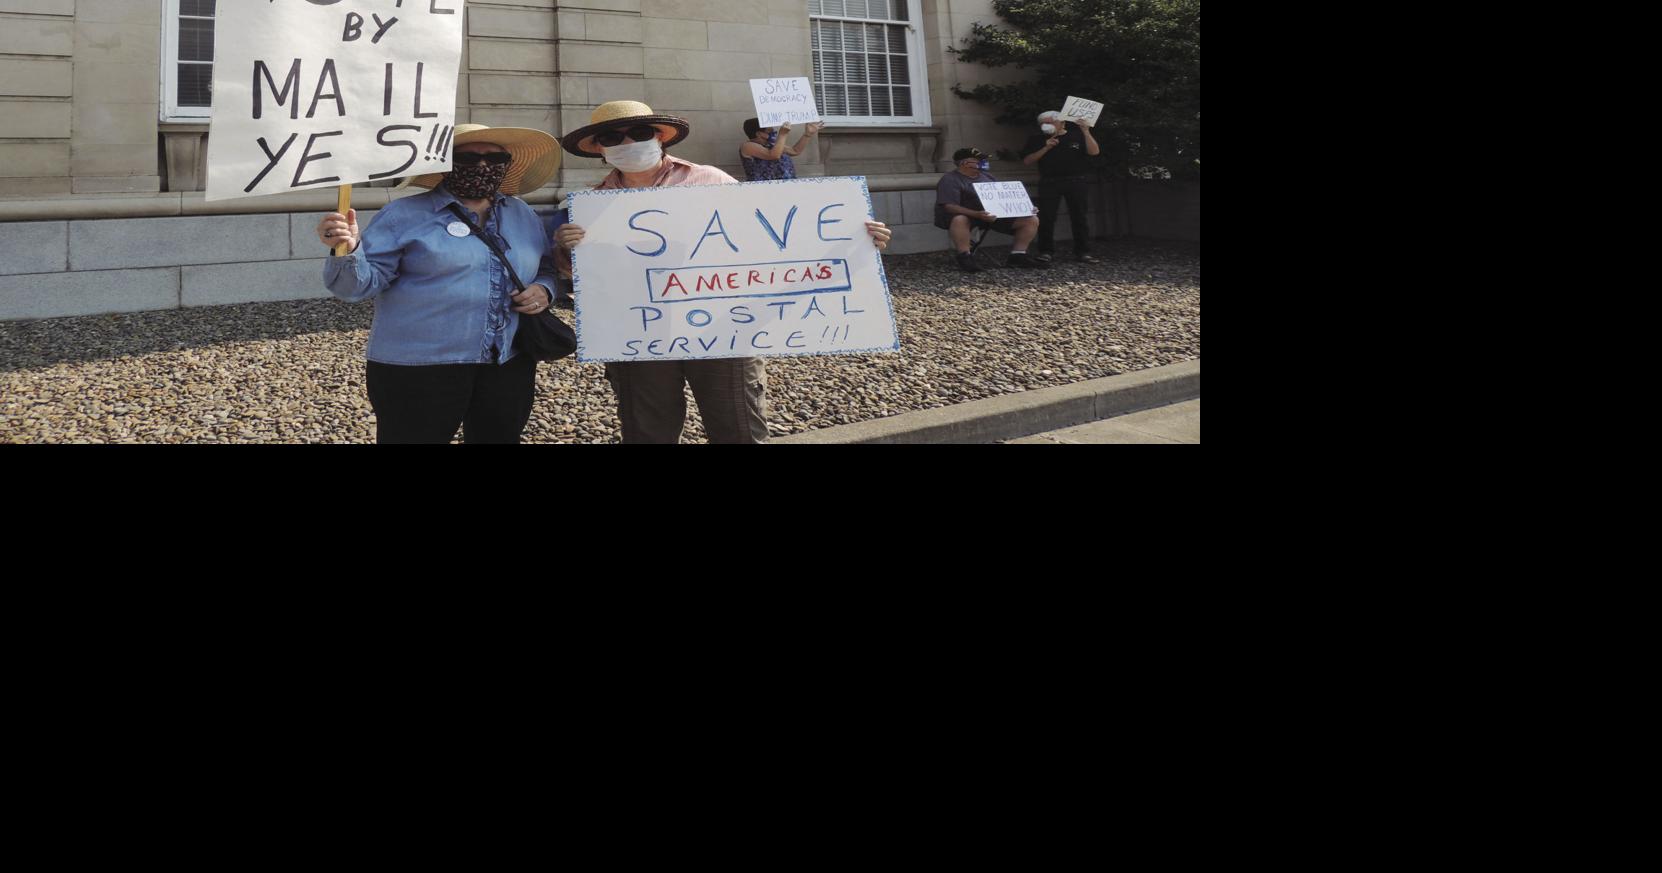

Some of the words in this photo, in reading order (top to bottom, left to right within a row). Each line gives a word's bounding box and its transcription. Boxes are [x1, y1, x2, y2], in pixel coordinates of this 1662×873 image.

[342, 12, 398, 44] BY
[252, 58, 438, 120] MAIL
[759, 93, 807, 104] DEMOCRACY
[765, 79, 799, 95] SAVE
[976, 182, 997, 191] VOTE
[1001, 182, 1023, 190] BLUE
[980, 191, 994, 201] NO
[626, 203, 853, 260] SAVE
[661, 262, 833, 297] AMERICA'S
[630, 295, 865, 332] POSTAL
